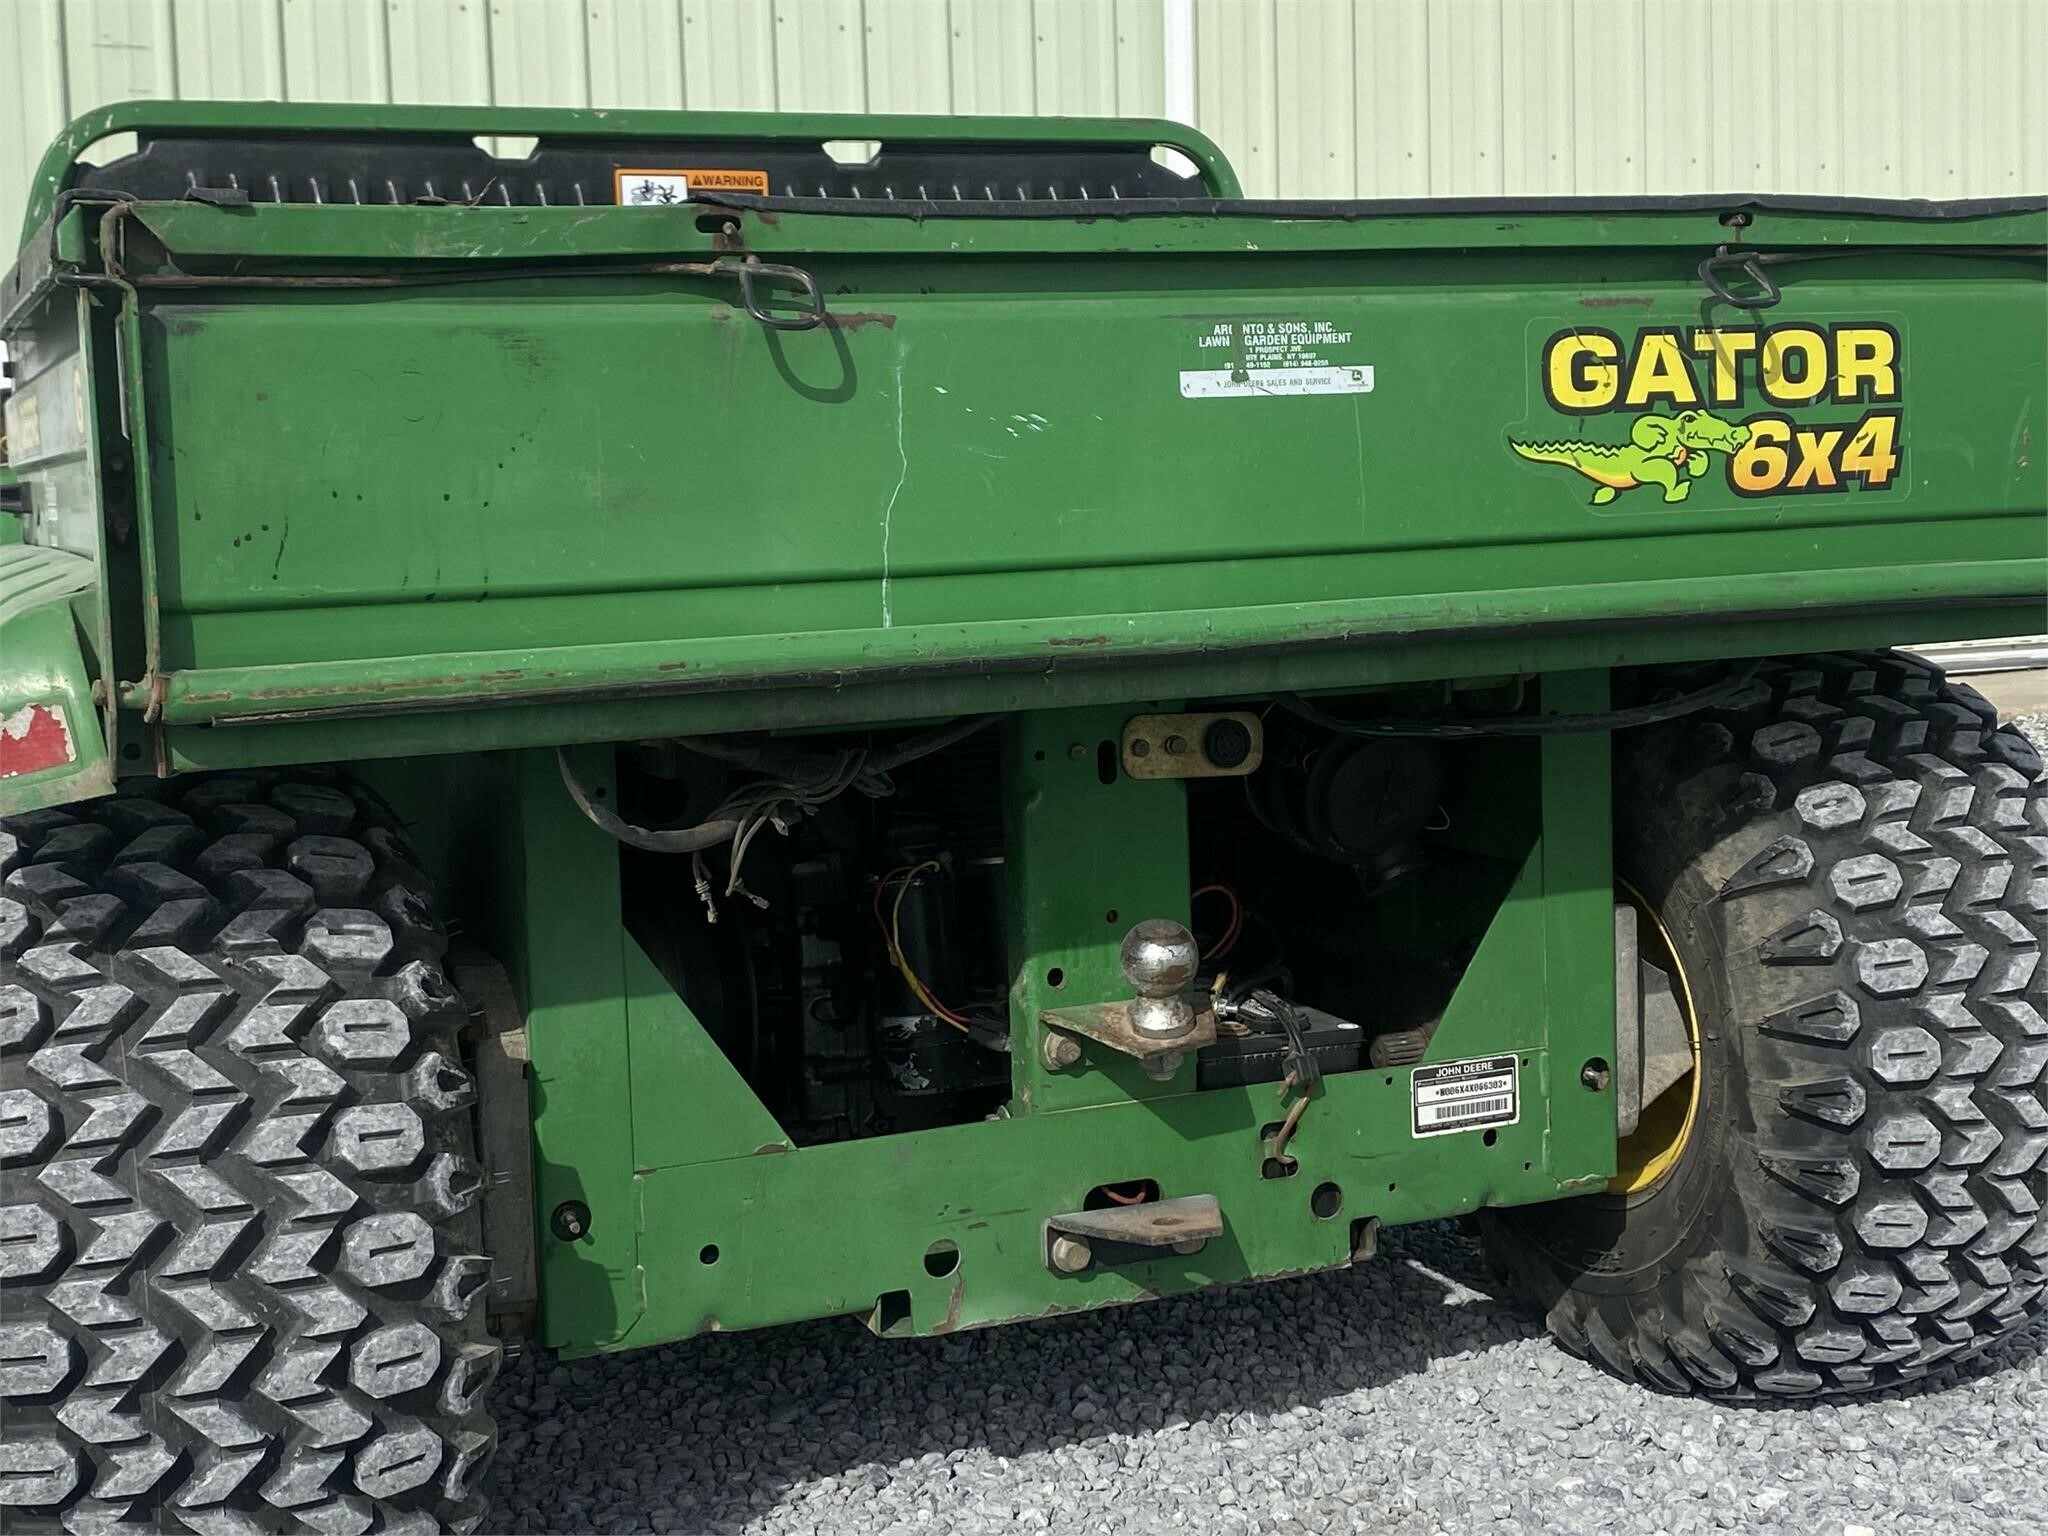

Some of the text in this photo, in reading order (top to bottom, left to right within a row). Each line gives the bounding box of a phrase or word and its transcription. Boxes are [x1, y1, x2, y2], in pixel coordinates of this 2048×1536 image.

[702, 175, 764, 187] WARNING
[1213, 323, 1264, 334] ARNTO
[1267, 323, 1276, 334] &
[1314, 322, 1336, 333] INC.
[1198, 332, 1352, 348] LAWN GARDEN EQUIPMENT
[1546, 326, 1898, 410] GATOR
[1266, 378, 1289, 387] SALES
[1289, 378, 1303, 386] AND
[1305, 377, 1332, 386] SERVICE
[1731, 415, 1898, 492] 6x4
[1436, 1061, 1494, 1078] JOHN DEERE
